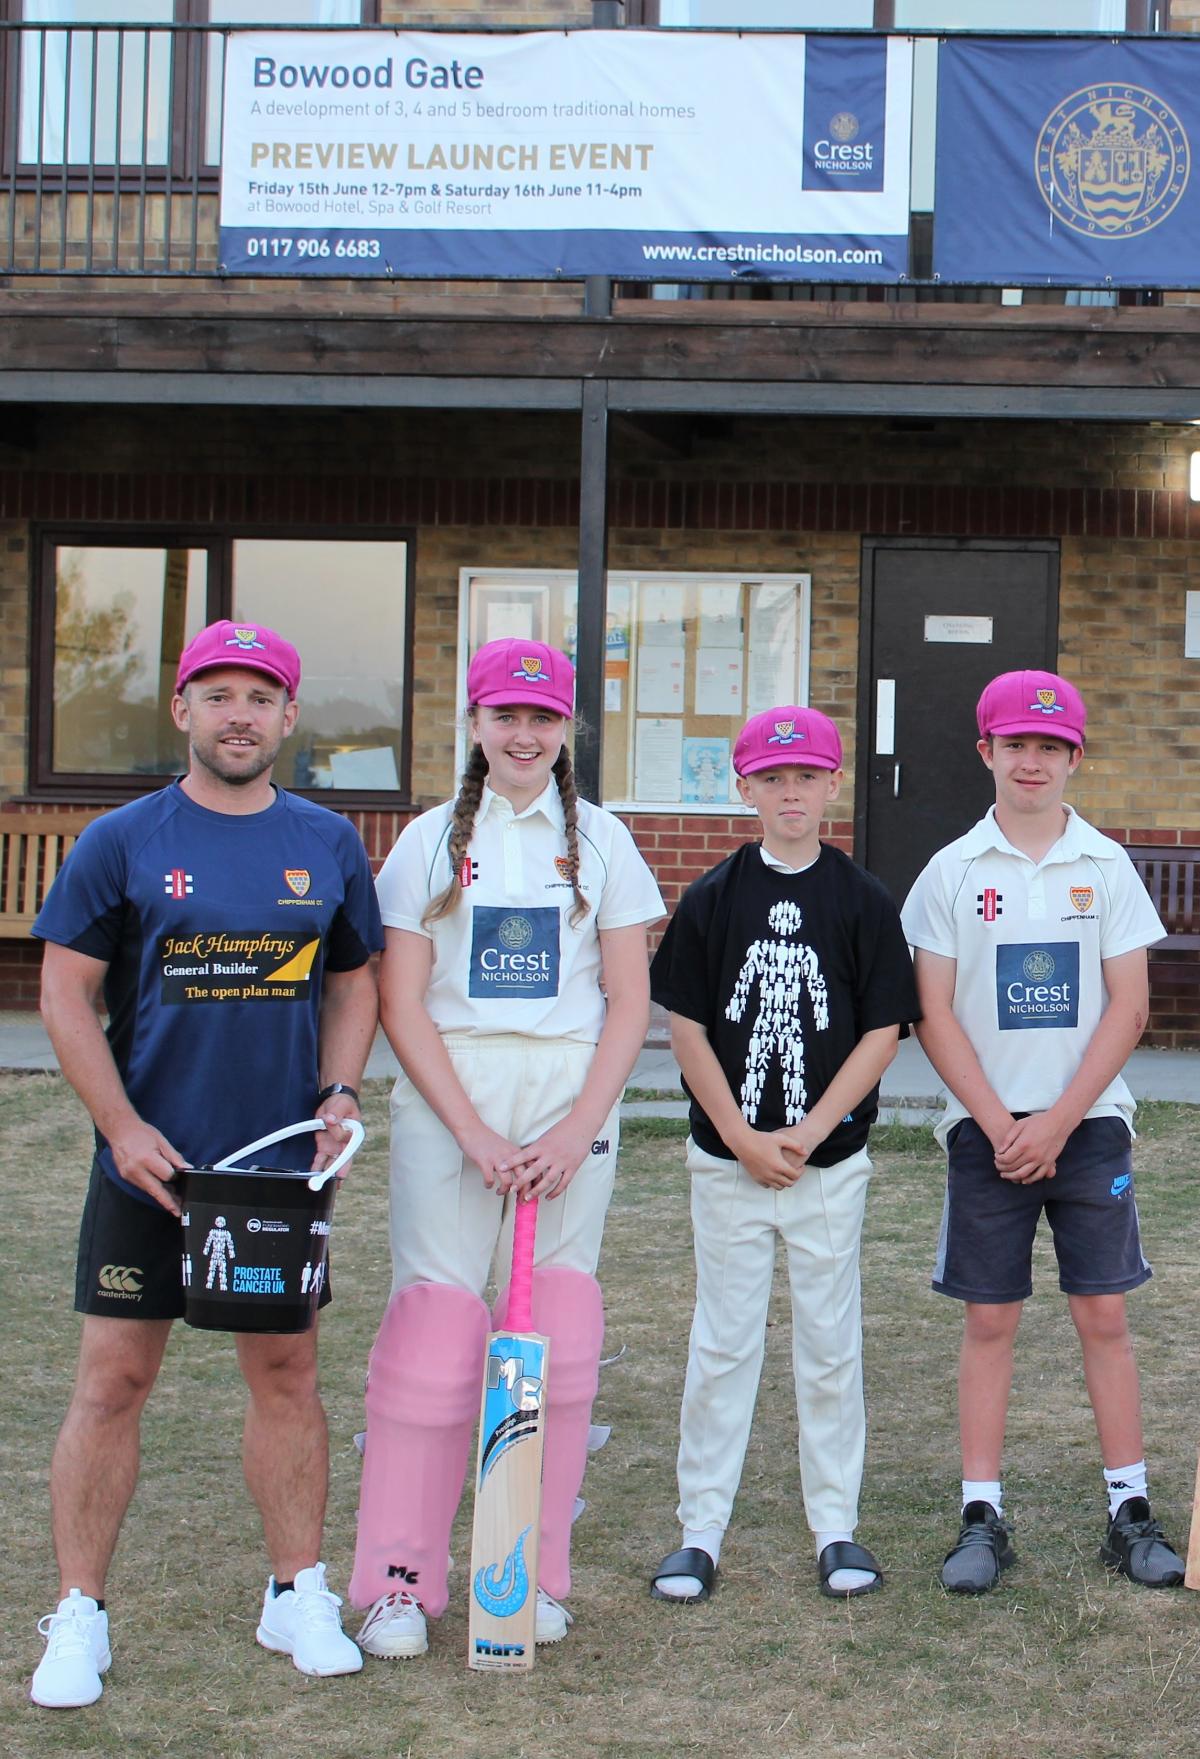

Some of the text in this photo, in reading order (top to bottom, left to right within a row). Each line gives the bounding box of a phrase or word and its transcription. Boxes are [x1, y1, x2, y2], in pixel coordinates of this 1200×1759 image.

[253, 57, 484, 89] Bowood Gate
[251, 100, 696, 119] A development of 3, 4 and 5 bedroom traditional homes
[251, 142, 654, 171] PREVIEW LAUNCH EVENT
[814, 140, 873, 161] Crest
[815, 160, 872, 170] NICHOLSON
[249, 181, 642, 199] Friday 15th June 12-7pm & Saturday 16th June 11-4pm
[248, 199, 492, 216] at Bowood Hotel, Spa & Golf Resort
[1069, 213, 1152, 232] 1963
[248, 238, 380, 258] 0117 906 6683
[642, 244, 883, 264] www.crestnicholson.com
[1061, 914, 1095, 922] CHIPPENHAM
[162, 933, 296, 959] Jack Humphrys
[480, 948, 550, 970] Crest
[163, 963, 259, 977] General Builder
[481, 973, 549, 982] NICHOLSON
[185, 985, 296, 999] The open plan man
[1007, 983, 1070, 1003] Crest
[1009, 1004, 1070, 1014] NICHOLSON
[591, 1140, 609, 1155] GM
[1113, 1174, 1130, 1187] NIKE
[234, 1267, 282, 1281] PROSTATE
[97, 1290, 142, 1302] canterbury
[233, 1280, 285, 1294] CANCER UK
[487, 1355, 543, 1411] MC
[388, 1565, 418, 1584] MC
[475, 1638, 525, 1656] Mars
